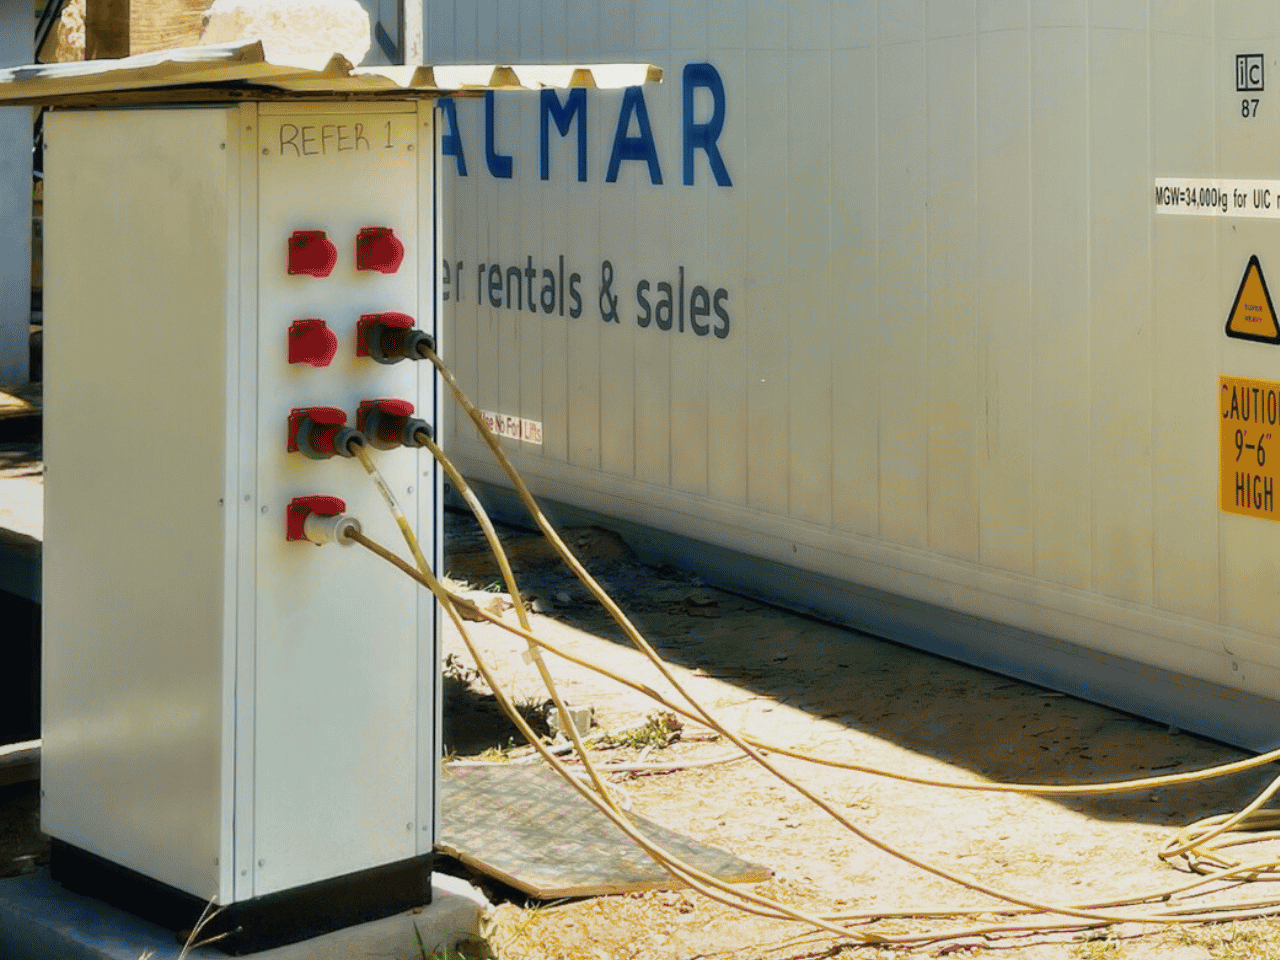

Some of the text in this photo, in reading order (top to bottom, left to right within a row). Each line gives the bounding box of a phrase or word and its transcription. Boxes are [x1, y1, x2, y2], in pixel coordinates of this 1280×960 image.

[1241, 98, 1260, 118] 87
[279, 120, 394, 158] REFER 1
[1233, 188, 1248, 208] for
[1253, 189, 1271, 209] UIC
[477, 254, 583, 320] rentals
[599, 260, 621, 324] &
[636, 266, 731, 339] sales
[1234, 471, 1274, 513] HIGH
